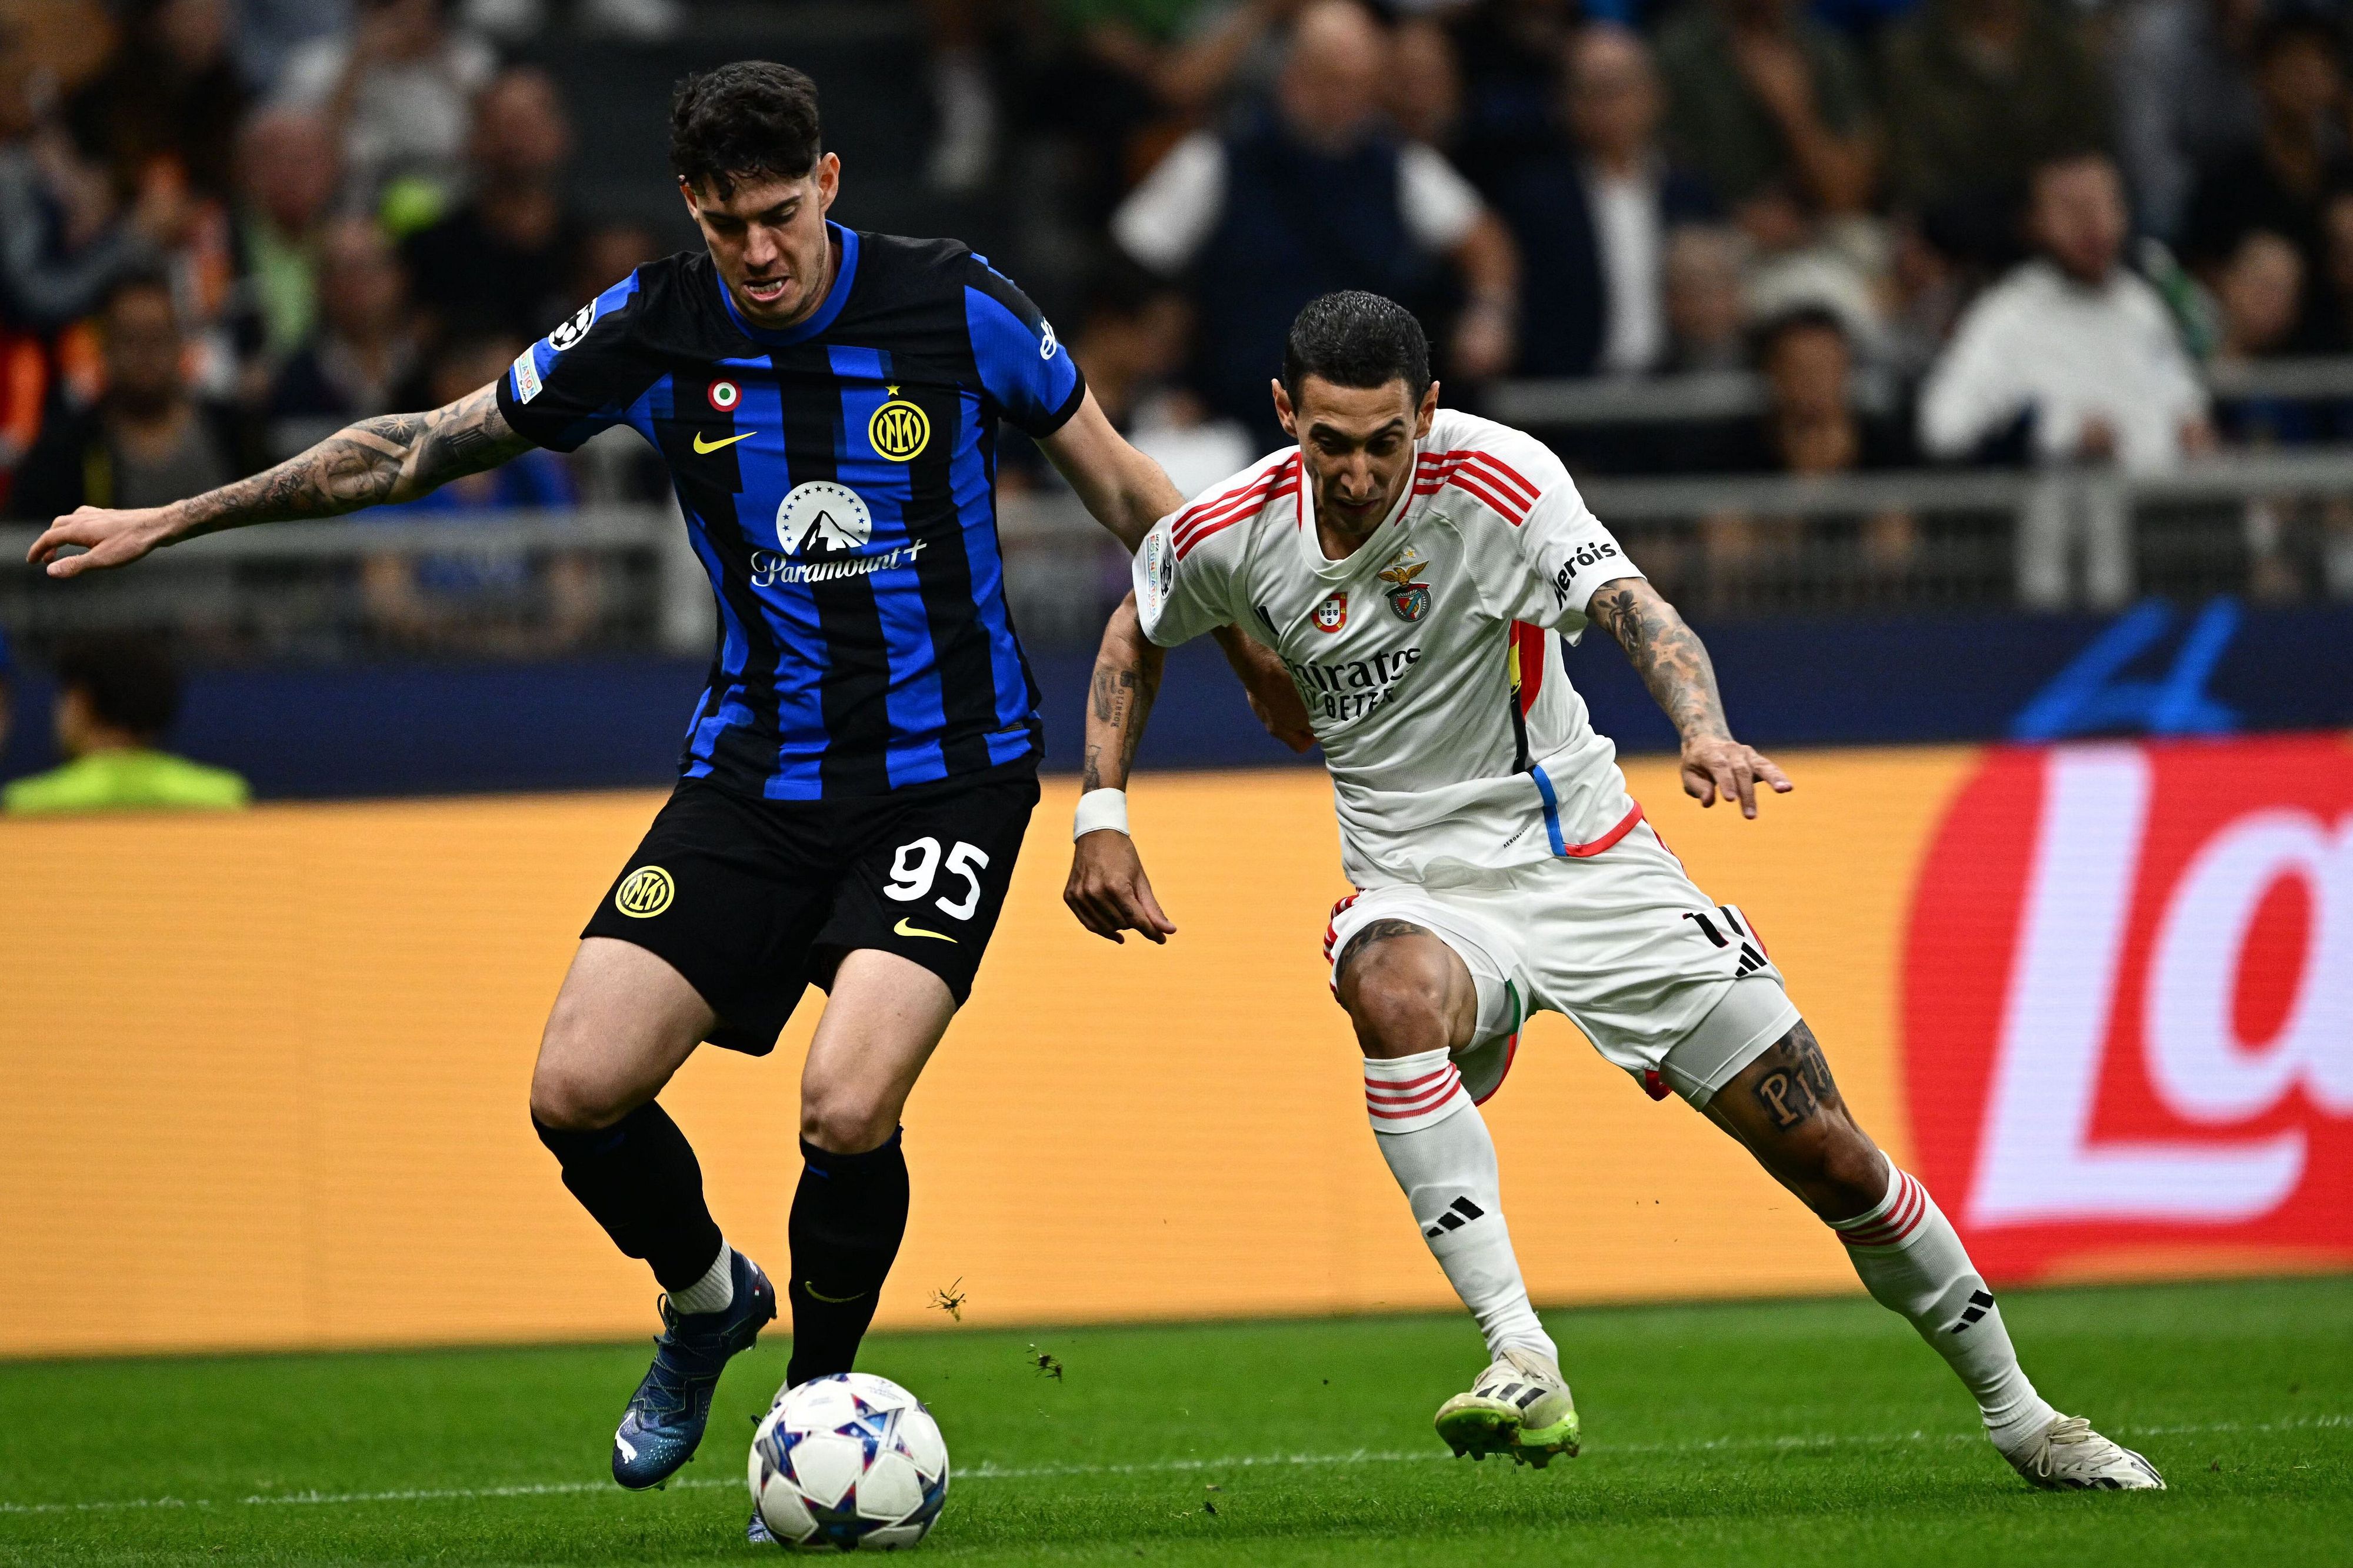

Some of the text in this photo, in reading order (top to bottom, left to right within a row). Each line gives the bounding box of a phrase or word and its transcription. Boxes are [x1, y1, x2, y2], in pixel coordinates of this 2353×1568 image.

[750, 538, 928, 588] Paramount+
[1552, 542, 1617, 612] Heróis
[1110, 689, 1125, 728] Rosario
[882, 836, 991, 922] 95
